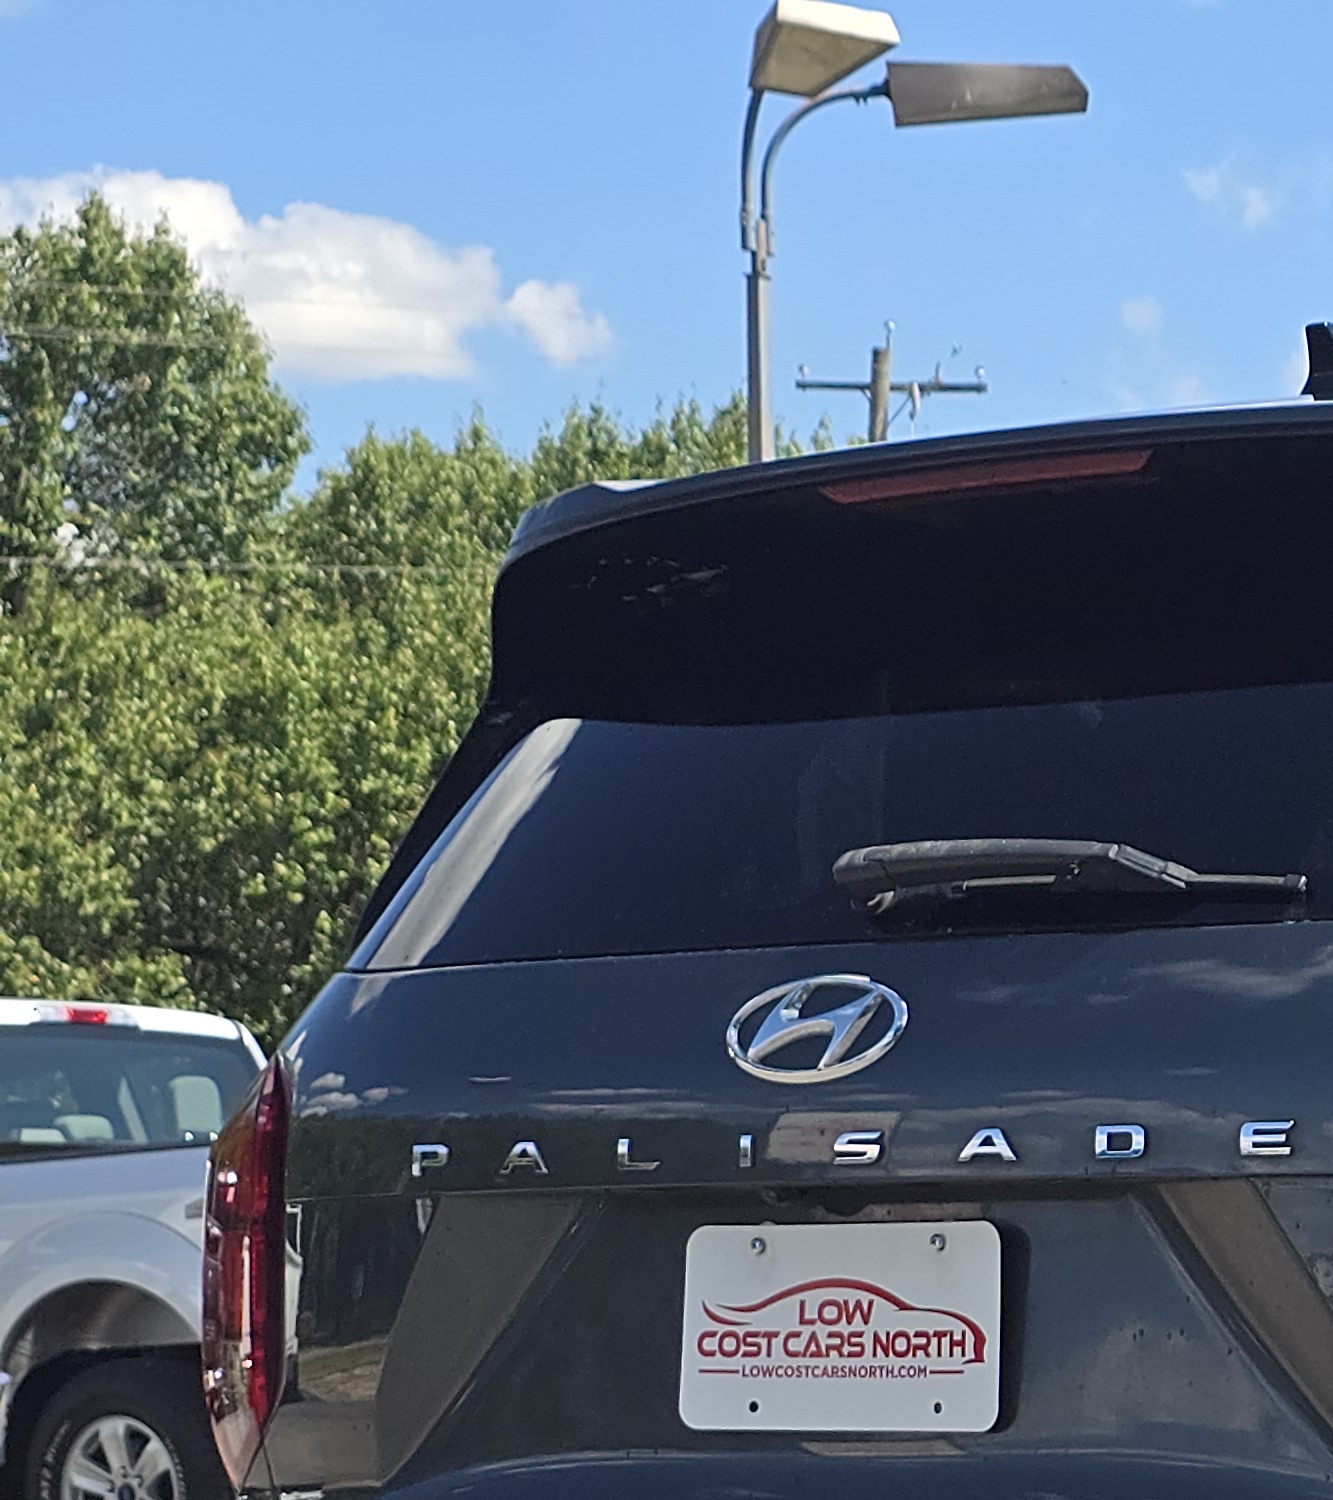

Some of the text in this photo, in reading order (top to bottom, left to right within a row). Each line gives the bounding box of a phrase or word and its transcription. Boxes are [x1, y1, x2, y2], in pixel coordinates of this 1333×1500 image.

[411, 1119, 1295, 1177] PALISADE
[799, 1299, 875, 1326] LOW
[697, 1329, 967, 1359] COST CARS NORTH
[741, 1364, 928, 1379] LOWCOSTCARSNORTH.COM
